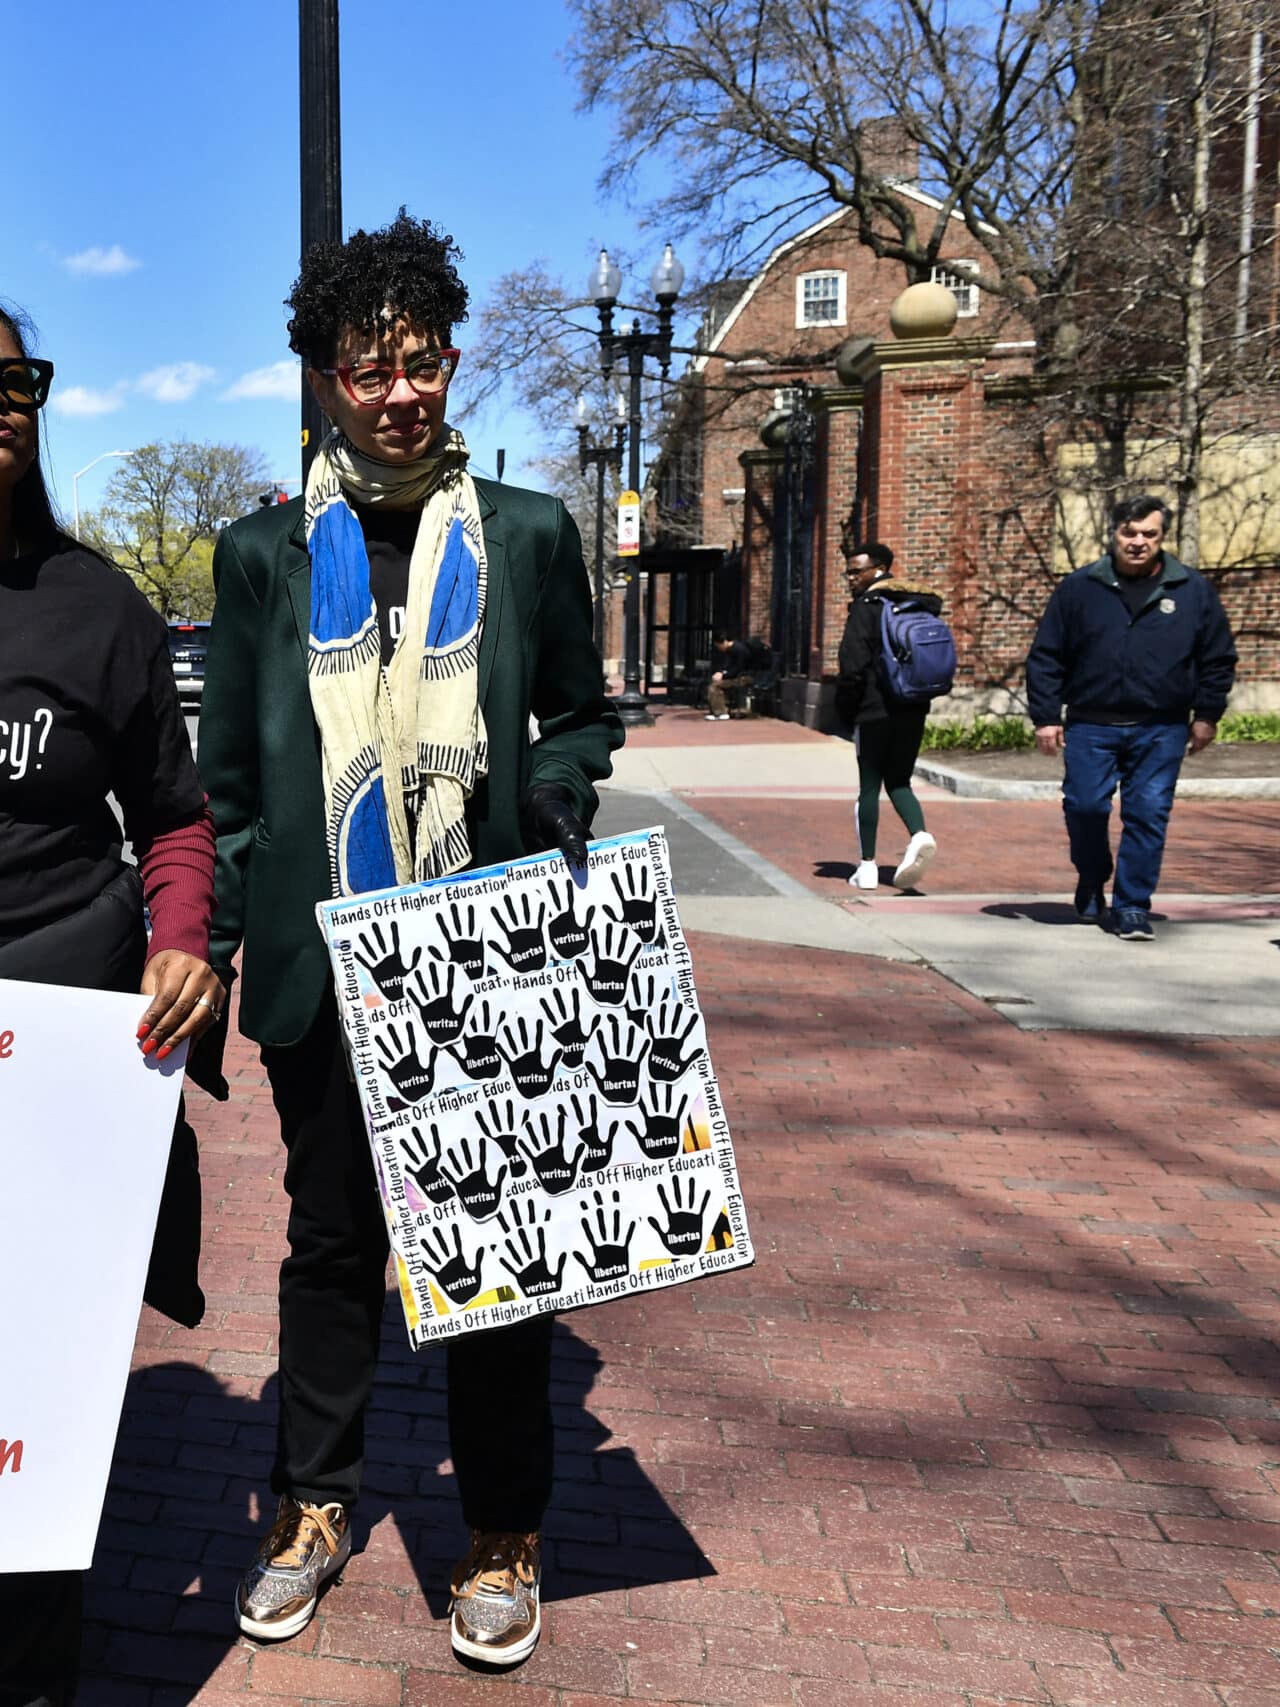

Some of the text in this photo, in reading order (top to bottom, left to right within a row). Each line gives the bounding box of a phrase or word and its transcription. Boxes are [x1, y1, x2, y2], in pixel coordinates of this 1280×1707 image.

[506, 863, 546, 883] Hands
[331, 877, 508, 927] Hands Off Higher Education
[648, 833, 697, 1010] Education Hands Off Higher
[554, 931, 586, 945] veritas
[511, 946, 544, 964] libertas
[513, 972, 552, 991] Hands
[556, 967, 579, 983] Off
[592, 981, 624, 991] libertas
[351, 1005, 370, 1048] Higher
[427, 1019, 459, 1029] veritas
[357, 1052, 375, 1076] Off
[466, 1053, 500, 1070] libertas
[651, 1053, 680, 1072] veritas
[398, 1074, 429, 1089] veritas
[517, 1073, 548, 1084] veritas
[603, 1080, 637, 1091] libertas
[365, 1078, 388, 1120] Hands
[412, 1100, 435, 1120] Off
[438, 1091, 479, 1112] Higher
[482, 1080, 511, 1098] Educ
[712, 1120, 730, 1144] Off
[645, 1135, 678, 1149] libertas
[540, 1167, 571, 1180] veritas
[596, 1168, 620, 1185] Off
[623, 1162, 665, 1181] Higher
[717, 1147, 736, 1191] Higher
[464, 1192, 495, 1205] veritas
[433, 1201, 457, 1220] Off
[382, 1135, 435, 1320] Hands Off Higher Education
[727, 1194, 749, 1258] Education
[667, 1231, 700, 1245] libertas
[586, 1280, 627, 1300] Hands
[629, 1271, 653, 1288] Off
[655, 1261, 696, 1282] Higher
[593, 1263, 627, 1279] libertas
[445, 1275, 477, 1292] veritas
[525, 1280, 557, 1294] veritas
[421, 1291, 584, 1339] Hands Off Higher Educati
